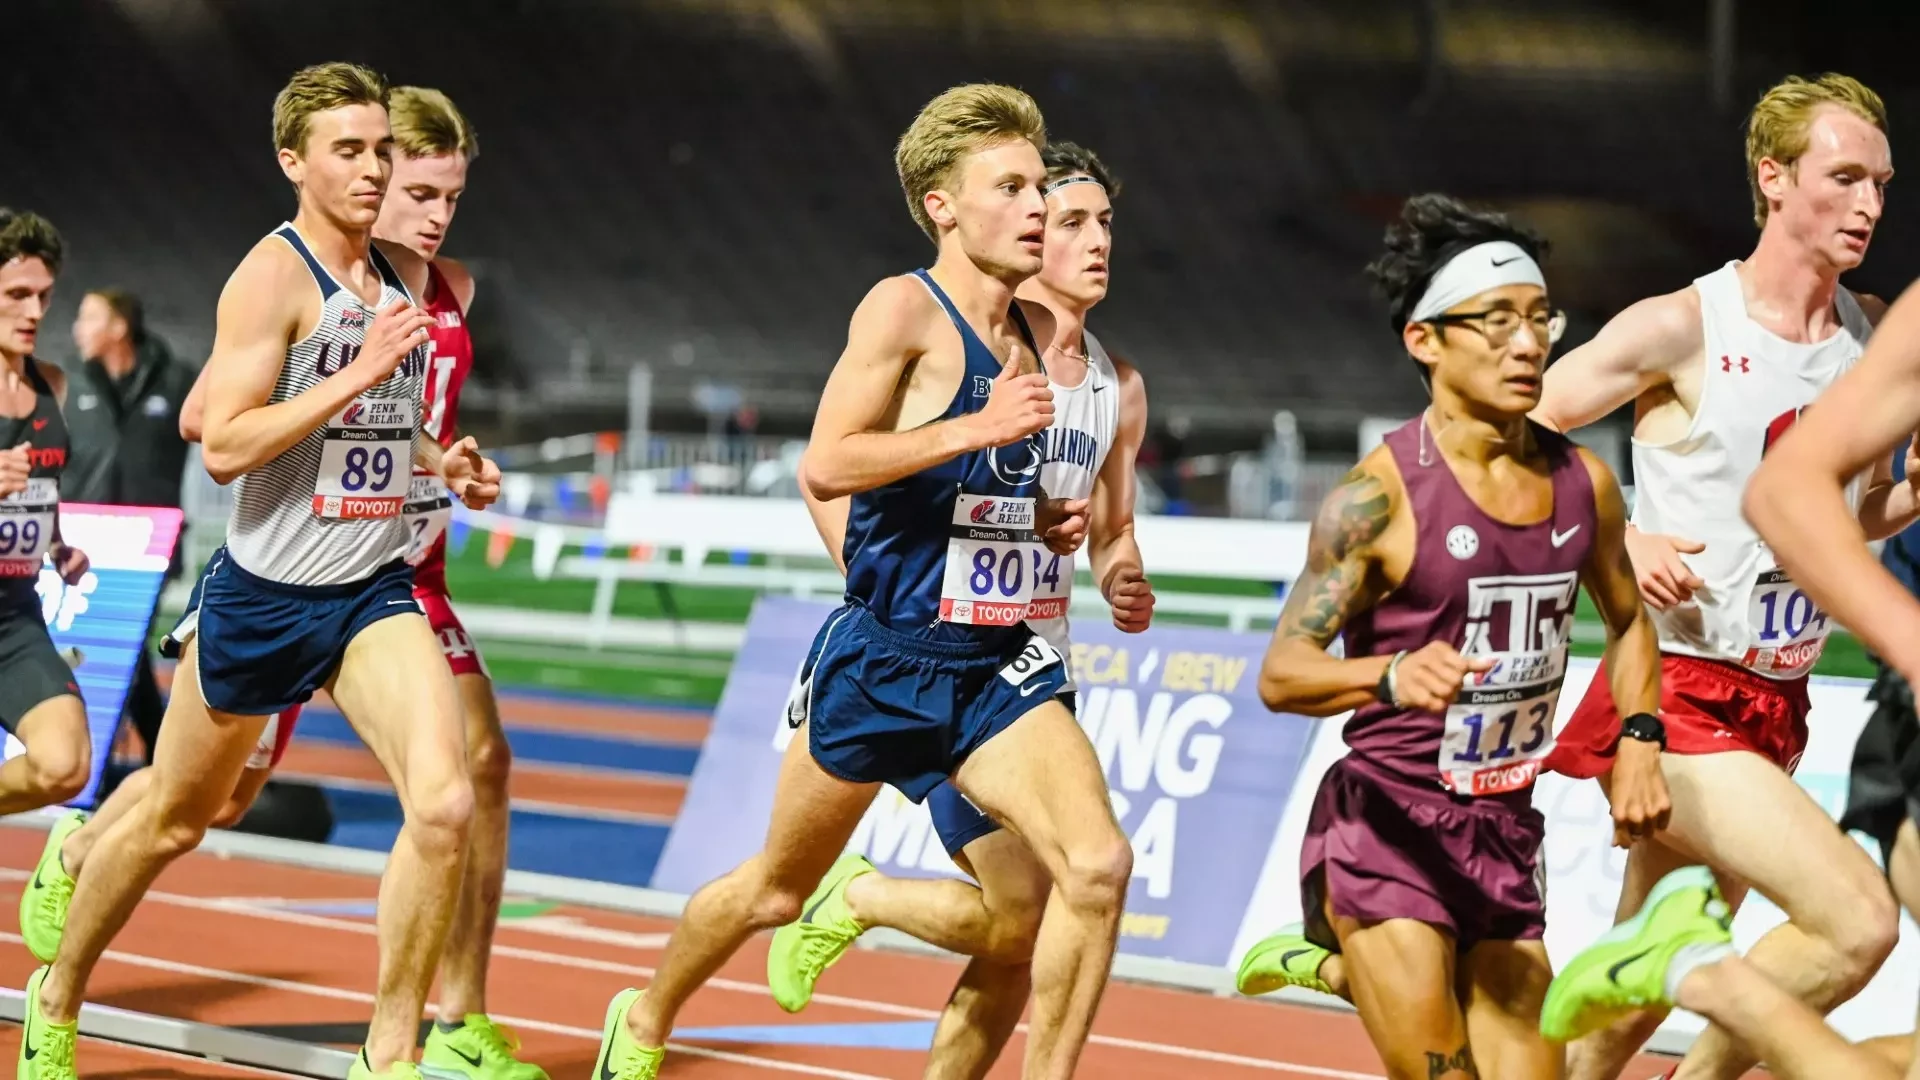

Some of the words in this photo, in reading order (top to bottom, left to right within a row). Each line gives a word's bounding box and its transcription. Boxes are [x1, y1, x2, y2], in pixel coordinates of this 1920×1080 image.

[316, 338, 425, 379] UNN
[370, 403, 398, 414] PENN
[368, 414, 405, 425] RELAYS
[341, 430, 367, 440] Dream
[27, 447, 66, 468] TON
[1043, 427, 1097, 475] LLANOV
[341, 446, 394, 493] 89
[345, 501, 396, 515] TOYOTA
[1000, 501, 1027, 513] PENN
[997, 513, 1031, 525] RELAYS
[0, 520, 40, 555] 99
[969, 529, 996, 540] Dream
[996, 530, 1009, 540] On.
[969, 547, 1024, 597] 80
[1028, 602, 1061, 617] OYOTA
[1071, 643, 1129, 684] ECA
[1512, 655, 1550, 669] PENN
[1453, 700, 1550, 763] 113
[1477, 763, 1537, 790] TOYOT
